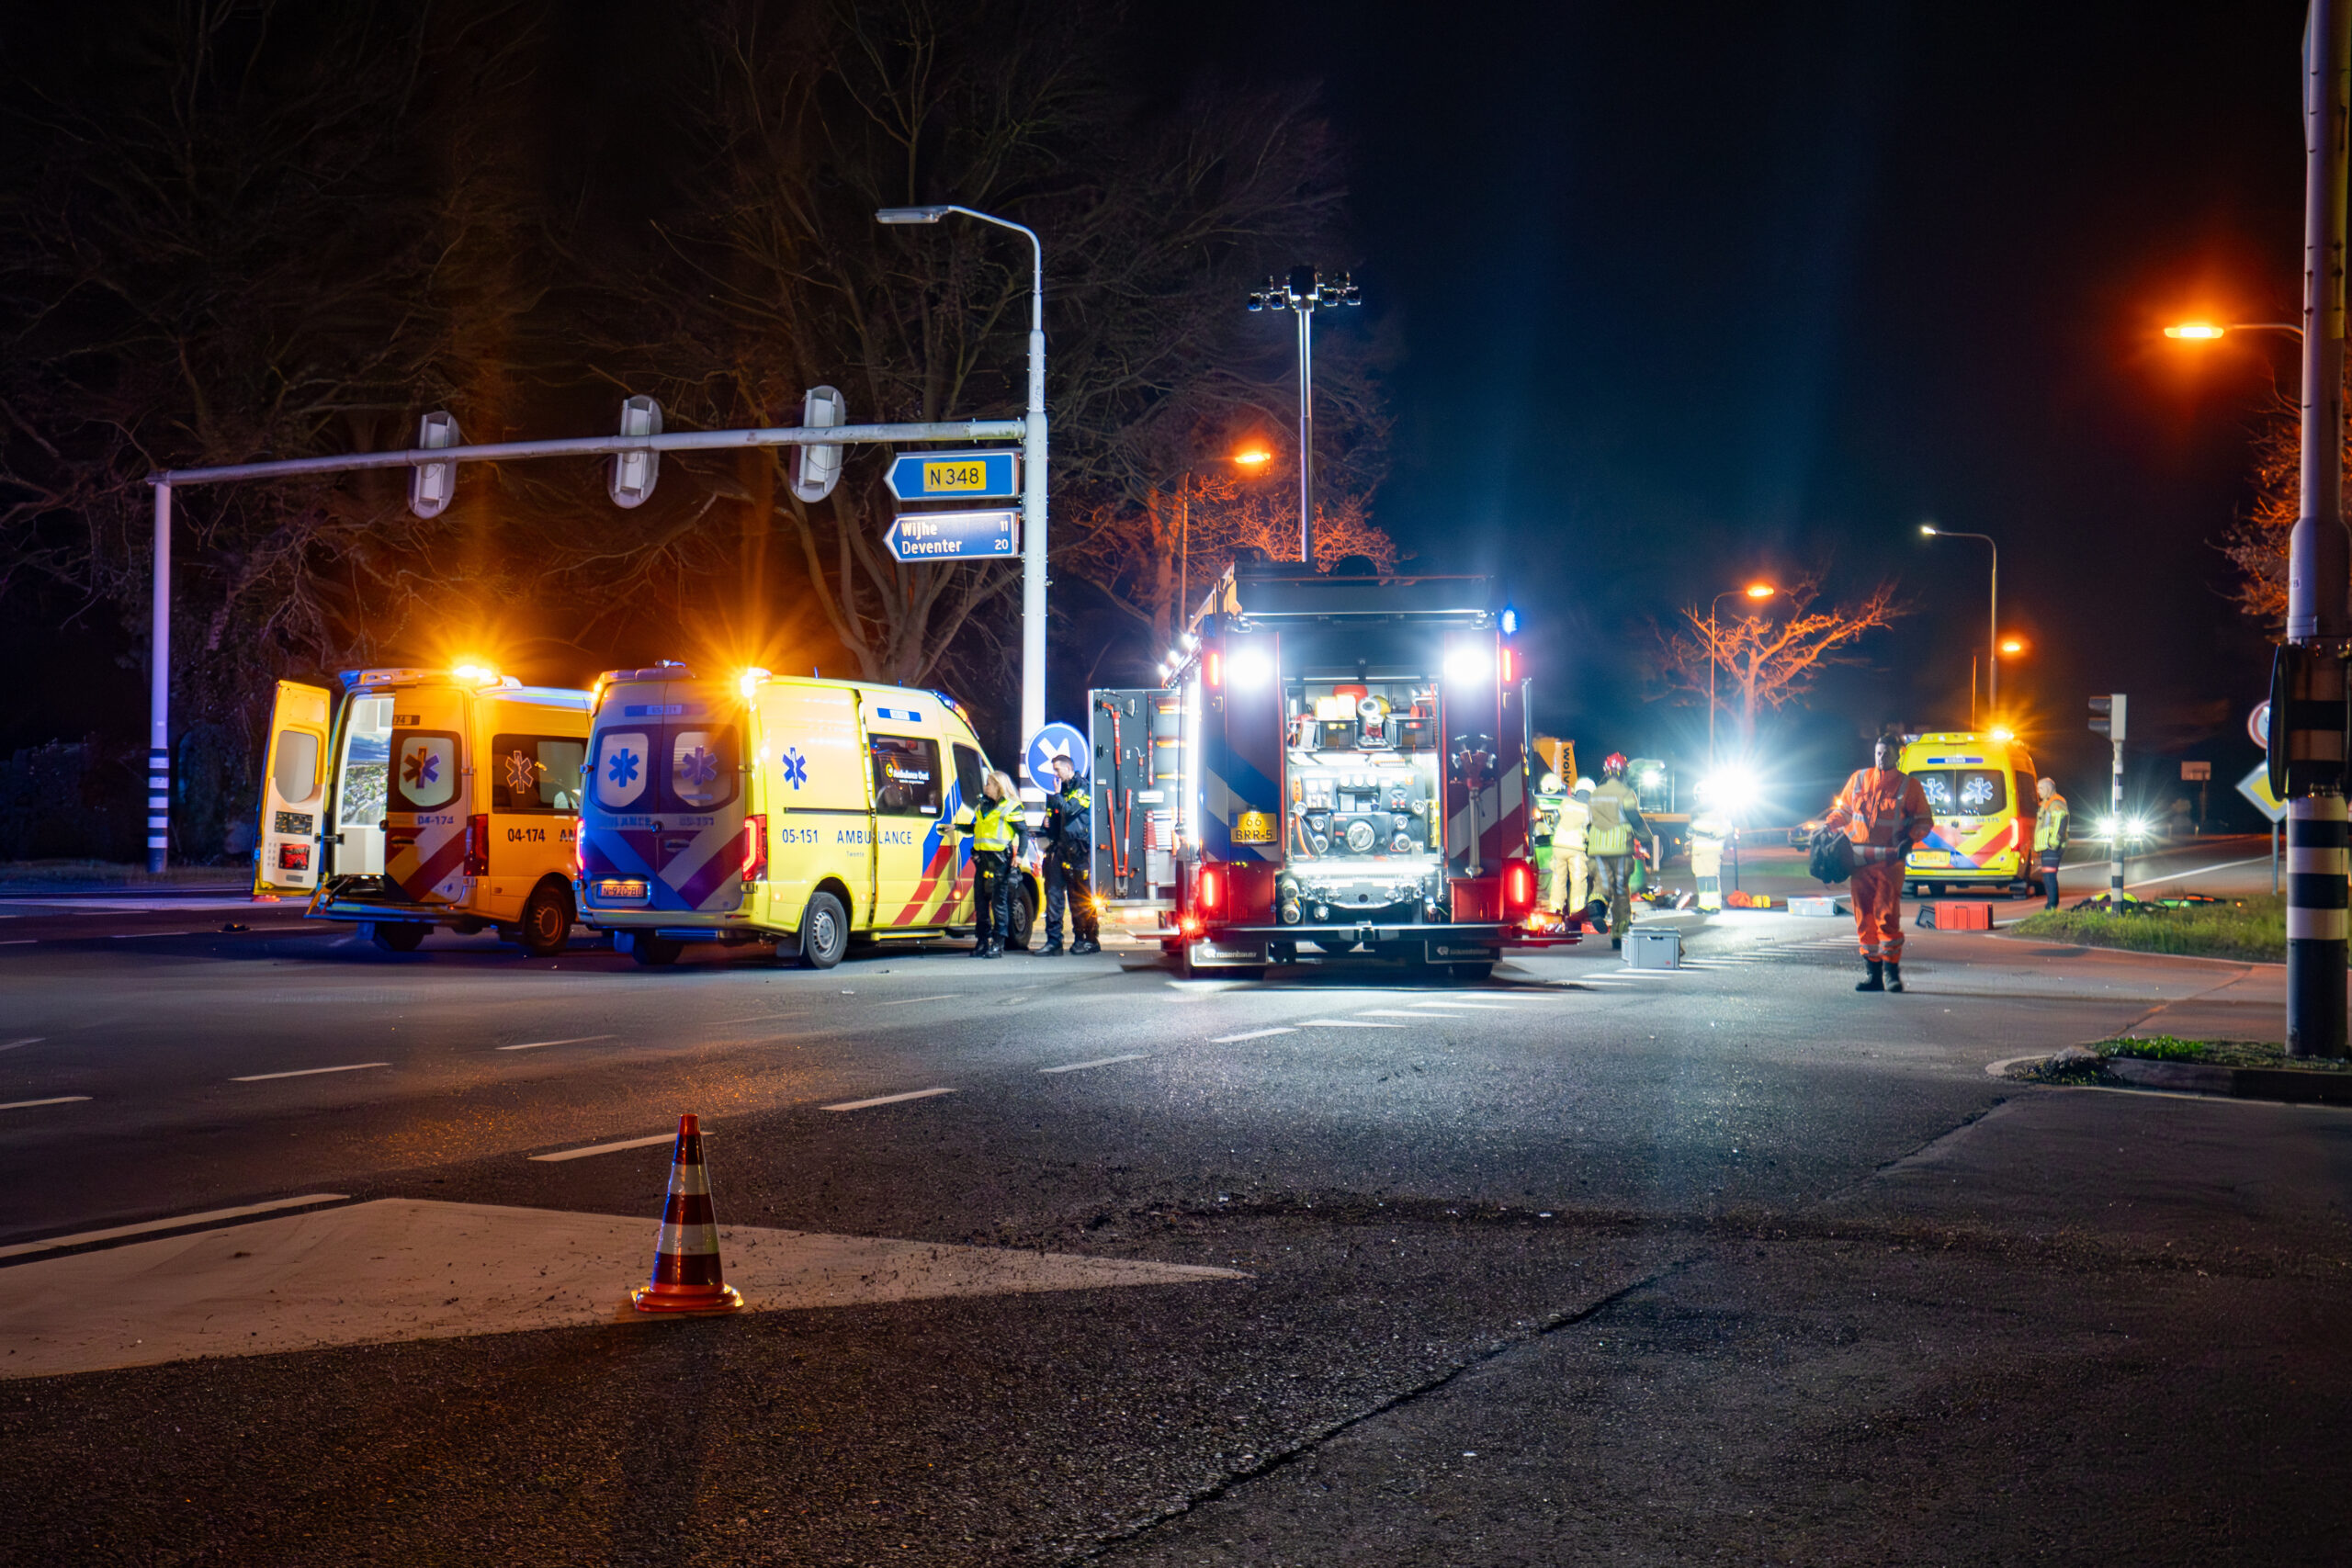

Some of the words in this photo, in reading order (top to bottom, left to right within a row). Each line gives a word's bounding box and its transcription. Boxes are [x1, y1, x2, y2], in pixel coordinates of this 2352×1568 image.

[945, 468, 979, 485] 348
[901, 521, 938, 540] Wijhe
[1000, 520, 1009, 532] 11
[901, 539, 963, 555] Deventer
[994, 538, 1009, 550] 20
[417, 815, 455, 826] 04-174
[507, 828, 547, 842] 04-174
[782, 829, 820, 844] 05-151
[836, 829, 912, 844] AMBULANCE
